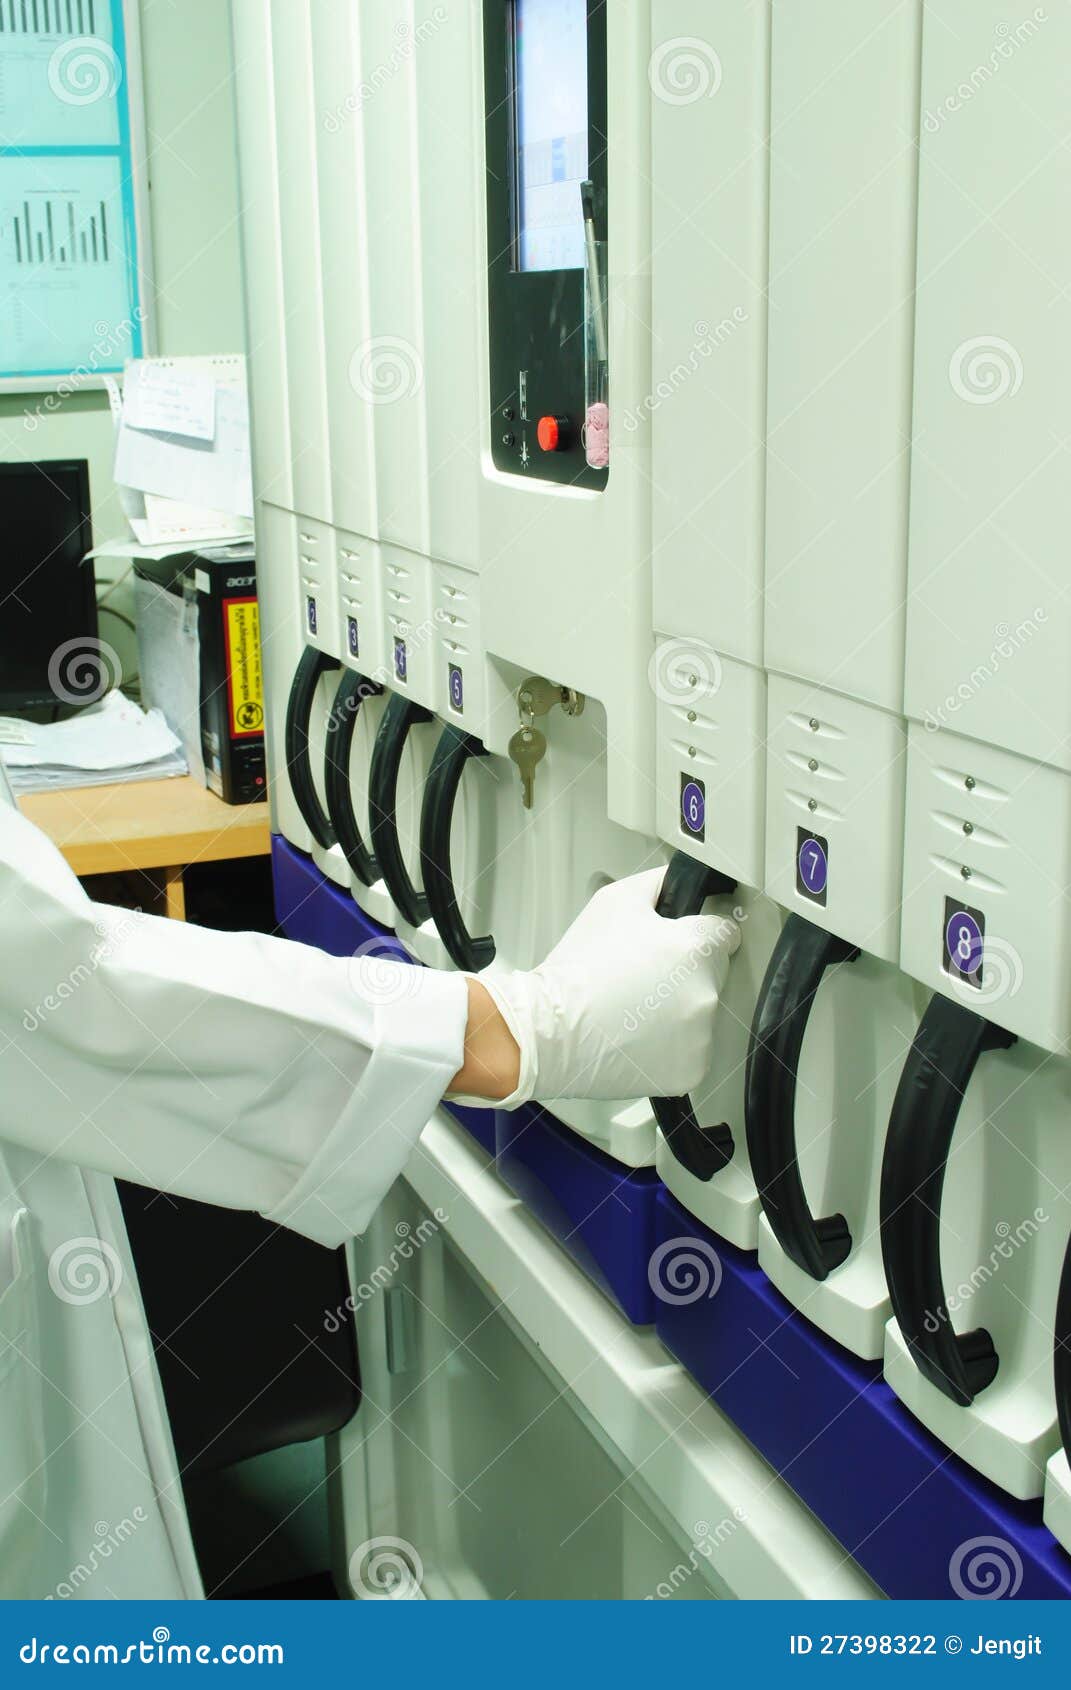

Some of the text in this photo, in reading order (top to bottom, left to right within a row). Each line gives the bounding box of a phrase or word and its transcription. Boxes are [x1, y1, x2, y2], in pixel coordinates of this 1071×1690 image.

[454, 678, 461, 700] 5
[689, 795, 698, 822] 6
[808, 851, 819, 881] 7
[957, 926, 972, 960] 8
